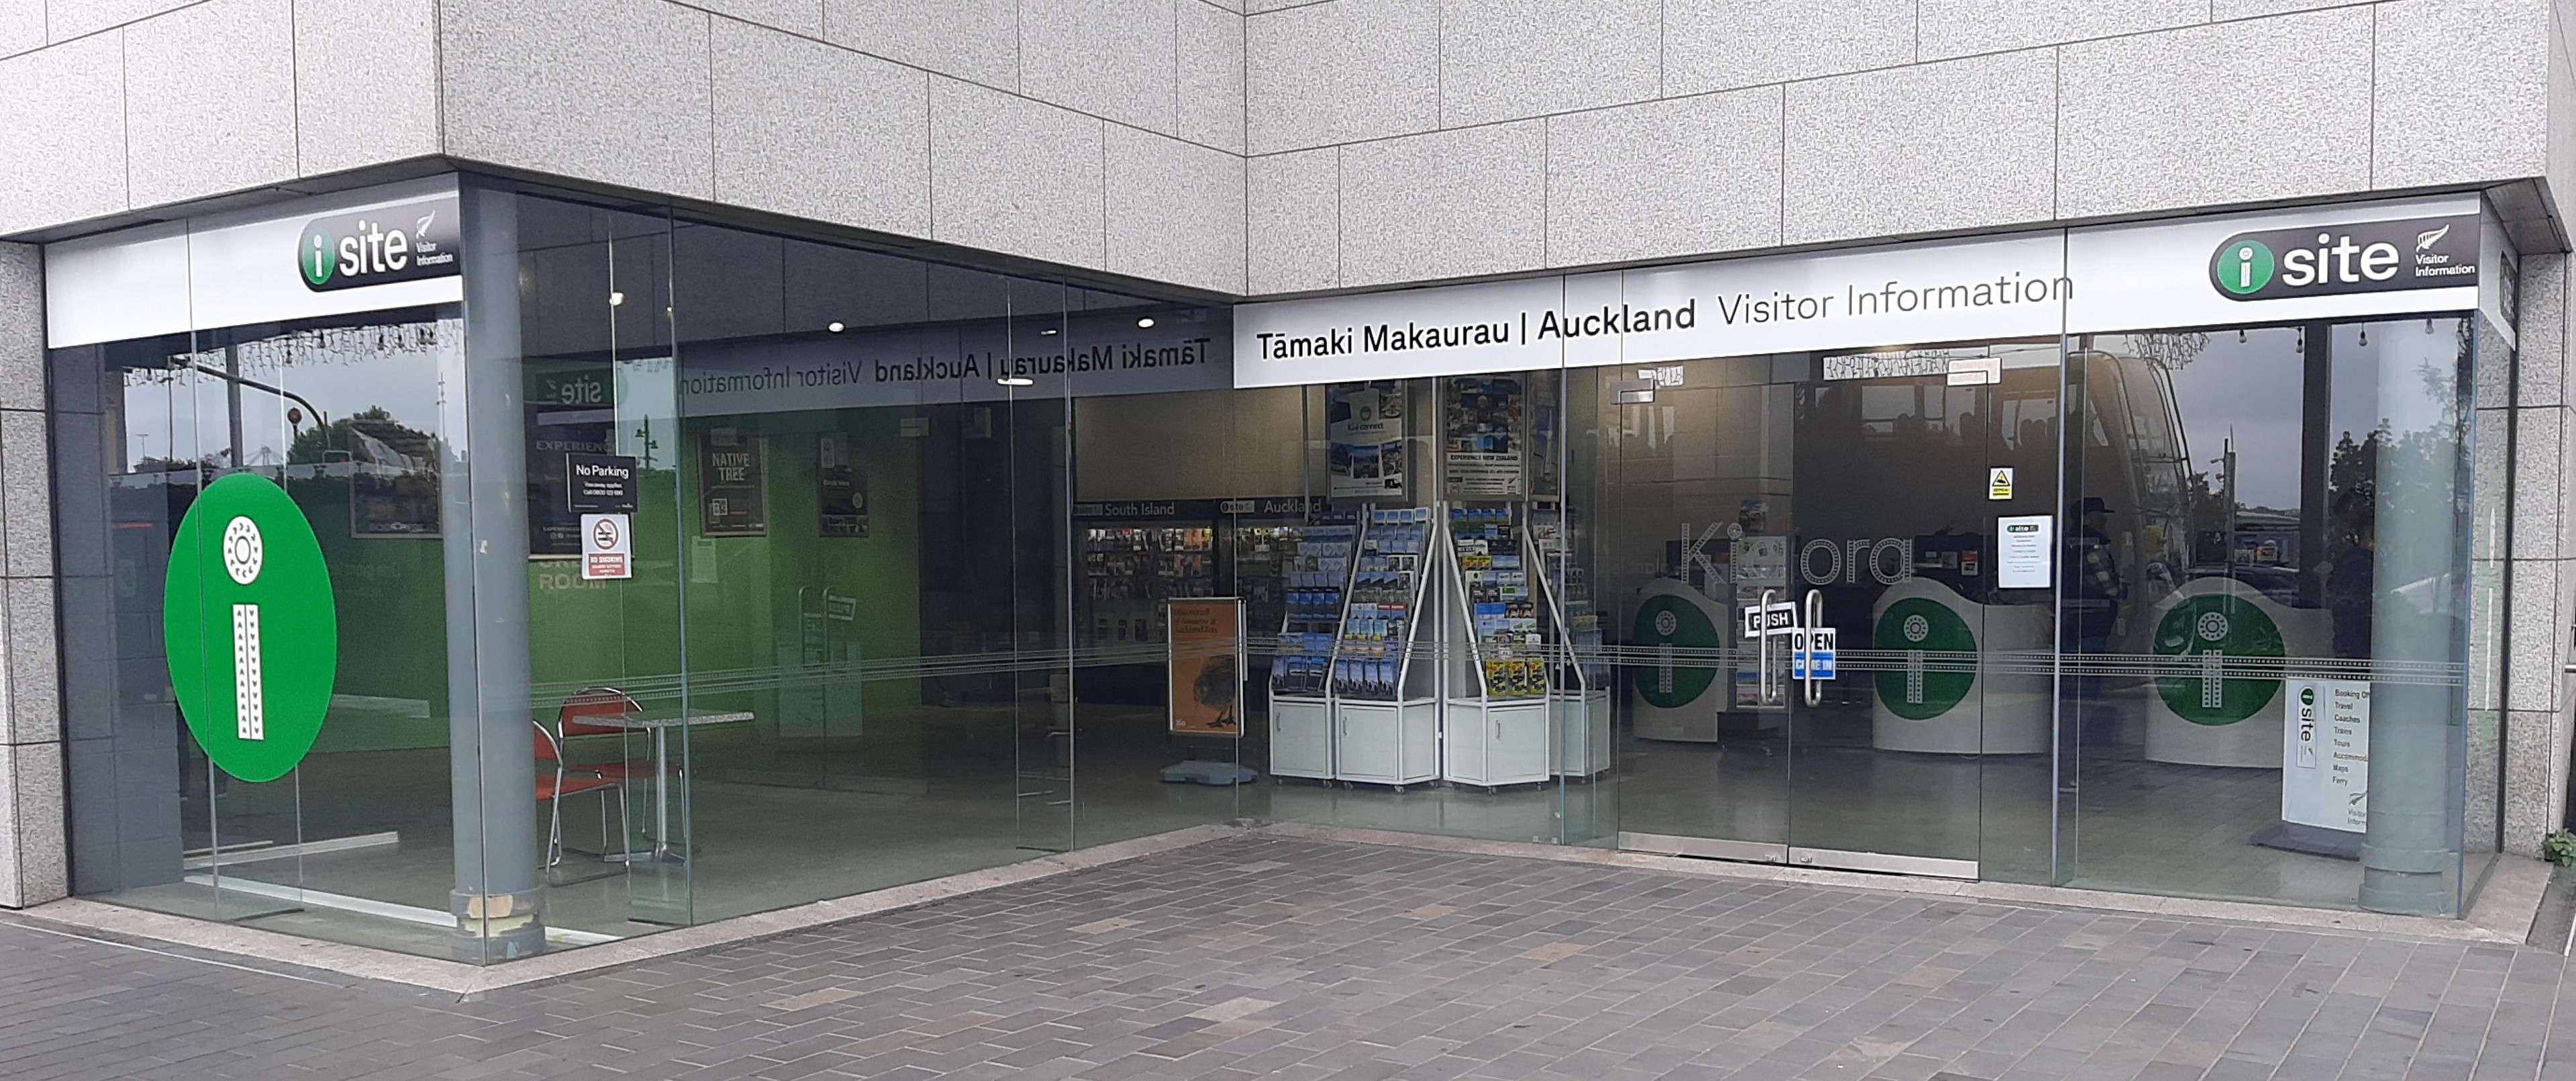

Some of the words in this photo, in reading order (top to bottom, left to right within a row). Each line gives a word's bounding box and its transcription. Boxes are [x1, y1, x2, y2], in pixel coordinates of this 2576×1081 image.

[339, 220, 408, 277] site
[415, 242, 437, 252] Visitor
[416, 252, 454, 267] Information
[2282, 232, 2399, 287] site
[2415, 253, 2449, 265] Visitor
[2415, 263, 2475, 277] Information
[1256, 327, 1352, 361] Tāmaki
[1364, 322, 1509, 353] Makaurau
[1538, 299, 1695, 340] Auckland
[1718, 291, 1834, 325] Visitor
[1848, 271, 2073, 316] Information
[712, 453, 750, 467] NATIVE
[576, 464, 591, 476] No
[592, 465, 630, 479] Parking
[718, 467, 745, 481] TREE
[1105, 503, 1138, 516] South
[1141, 503, 1175, 516] Island
[1681, 522, 1772, 584] Ki
[1800, 537, 1912, 585] ora
[1794, 633, 1834, 651] OEN
[2301, 708, 2314, 742] site
